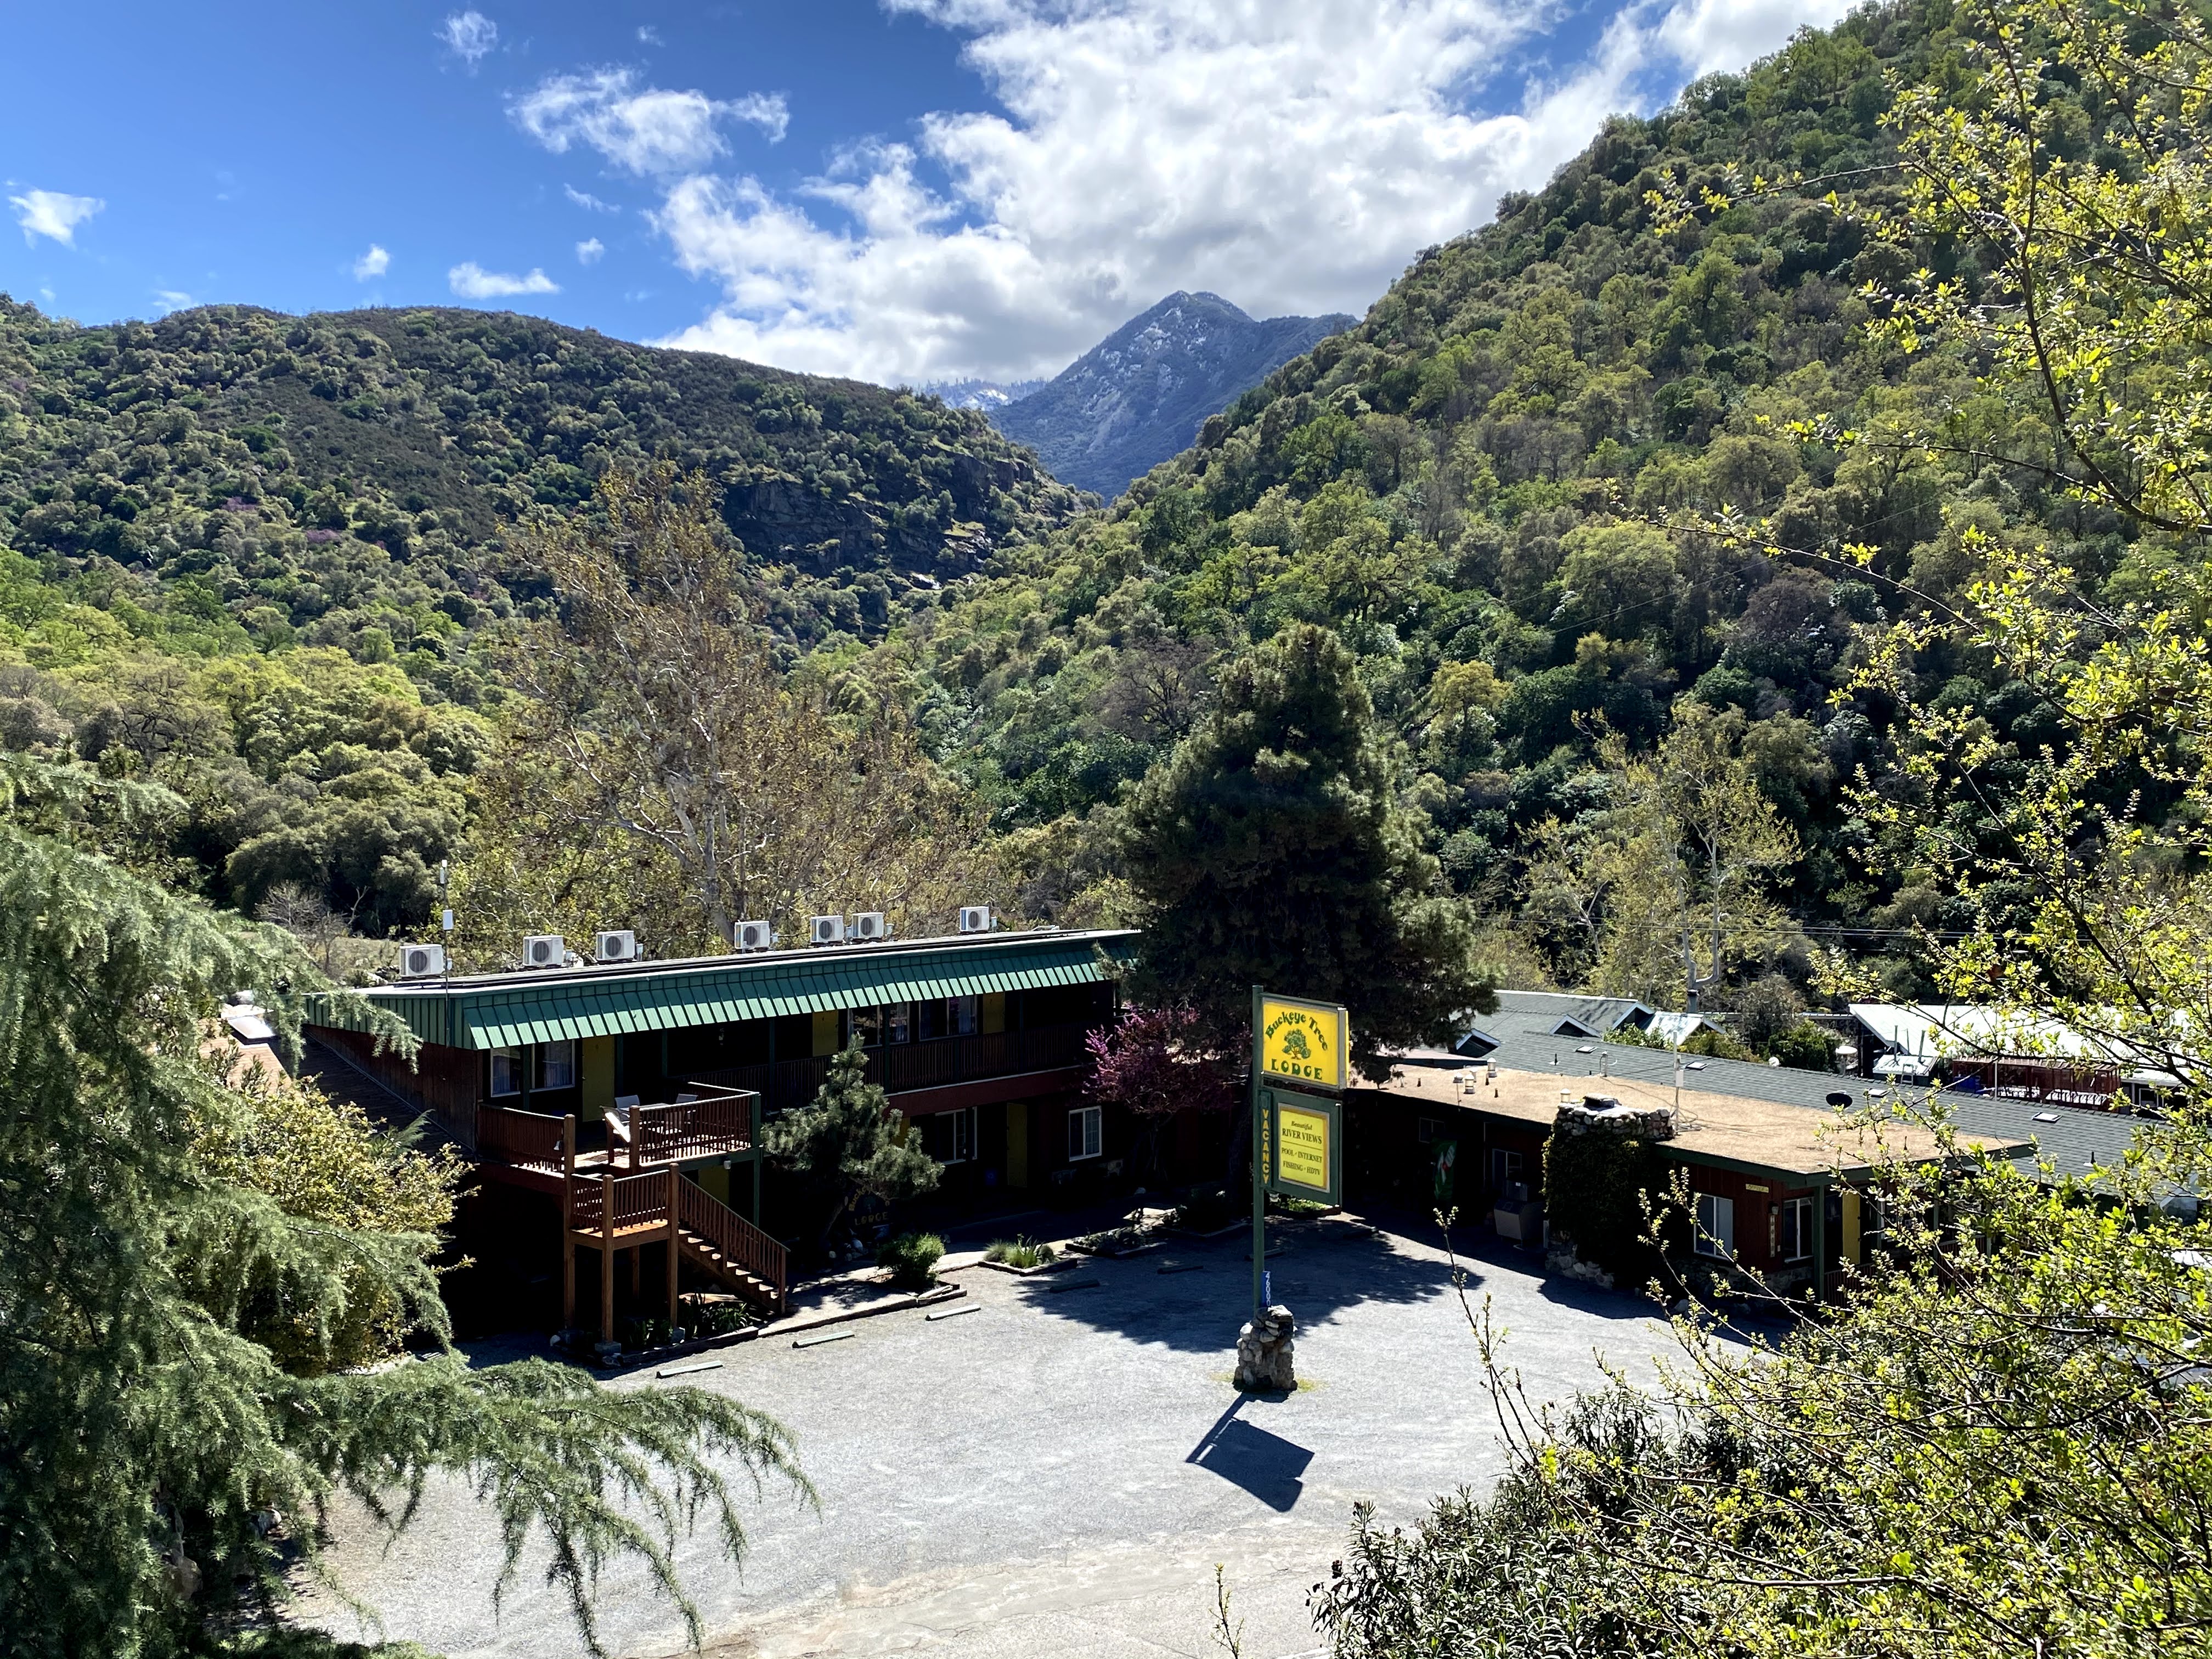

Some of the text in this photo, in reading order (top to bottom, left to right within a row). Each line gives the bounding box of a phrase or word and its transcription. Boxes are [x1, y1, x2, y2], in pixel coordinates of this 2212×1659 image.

[1266, 1012, 1328, 1051] Buckeye Tree
[1271, 1059, 1322, 1080] LODGE
[1291, 1121, 1312, 1130] Beautiful
[1282, 1128, 1322, 1144] RIVER VIEWS
[1282, 1148, 1322, 1163] POOL INTERNET
[1283, 1161, 1321, 1175] FISHING HDTV
